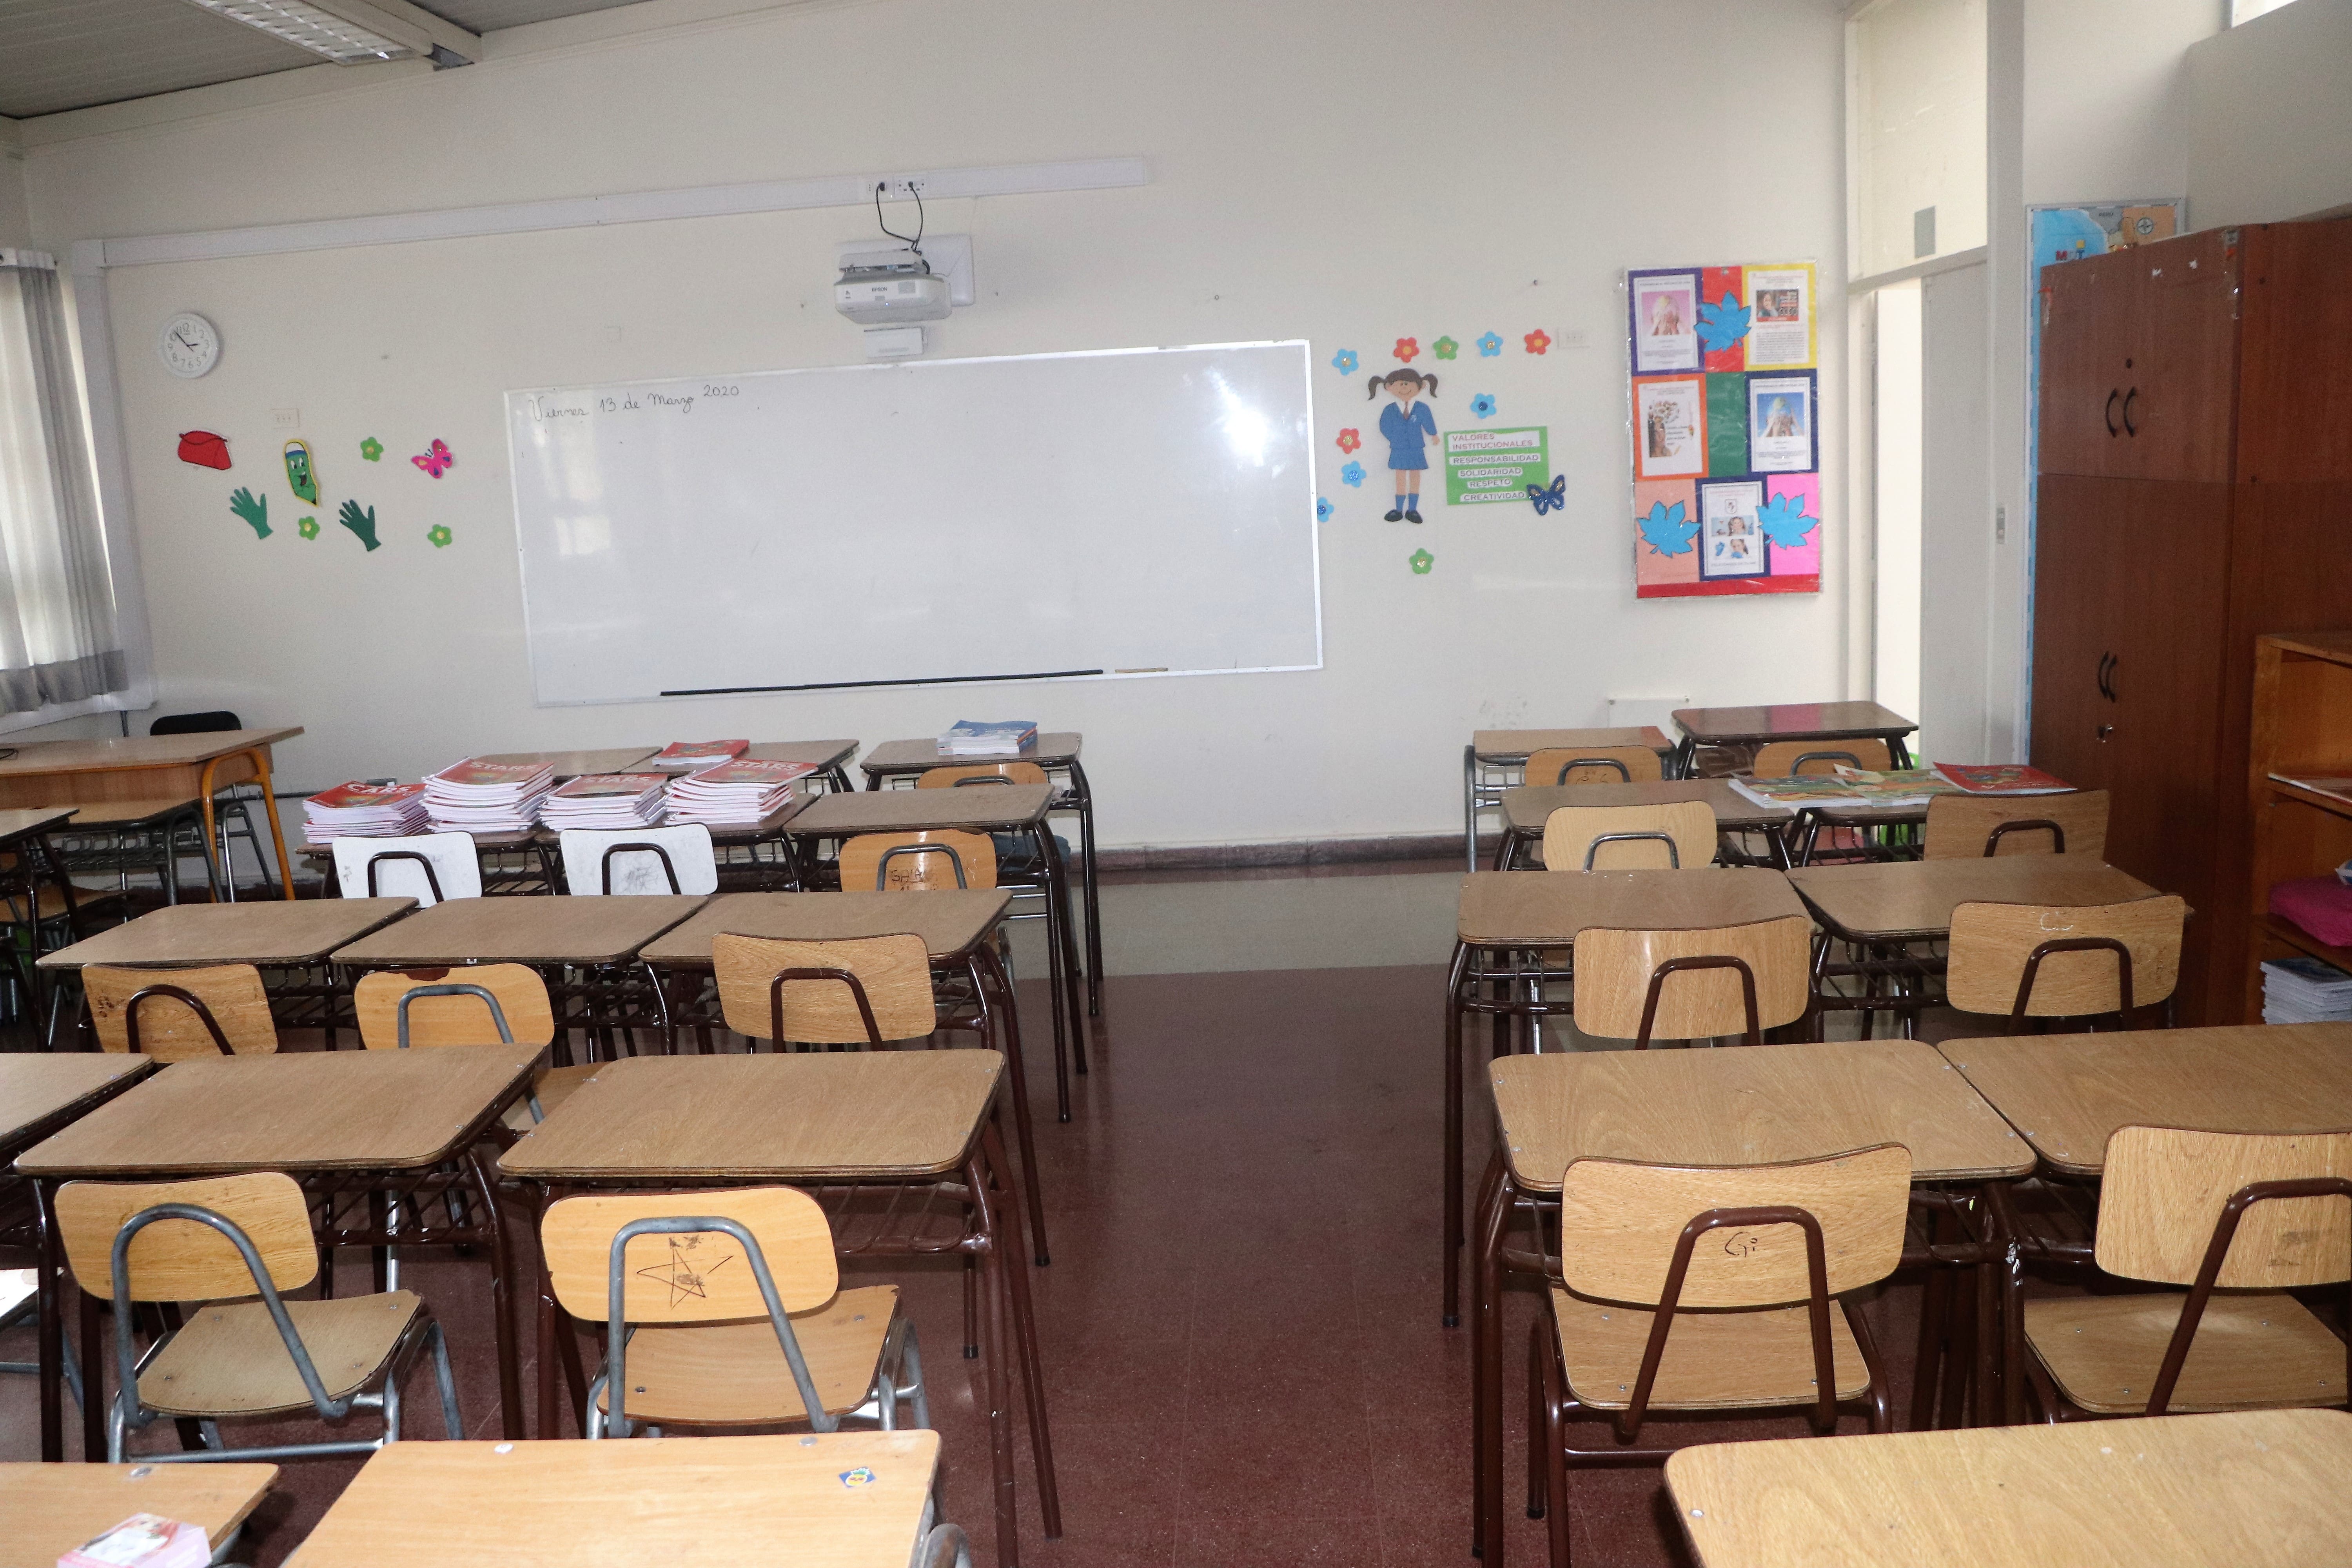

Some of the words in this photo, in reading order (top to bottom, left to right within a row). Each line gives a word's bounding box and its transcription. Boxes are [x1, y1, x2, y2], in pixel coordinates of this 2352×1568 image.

[172, 353, 178, 362] 8
[196, 357, 202, 366] 5
[599, 398, 617, 413] 13
[623, 392, 640, 409] de
[647, 393, 694, 414] Marzo
[703, 385, 740, 397] 2020
[1453, 440, 1532, 450] INSTITUCIONALES
[1454, 455, 1539, 463] RESPONSABILIDAD
[1461, 468, 1521, 476] SOLIDARIDAD
[1470, 479, 1511, 487] RESPETO
[1464, 492, 1524, 500] CREATIVIDAD
[469, 761, 539, 771] STARS
[731, 760, 804, 770] STARS
